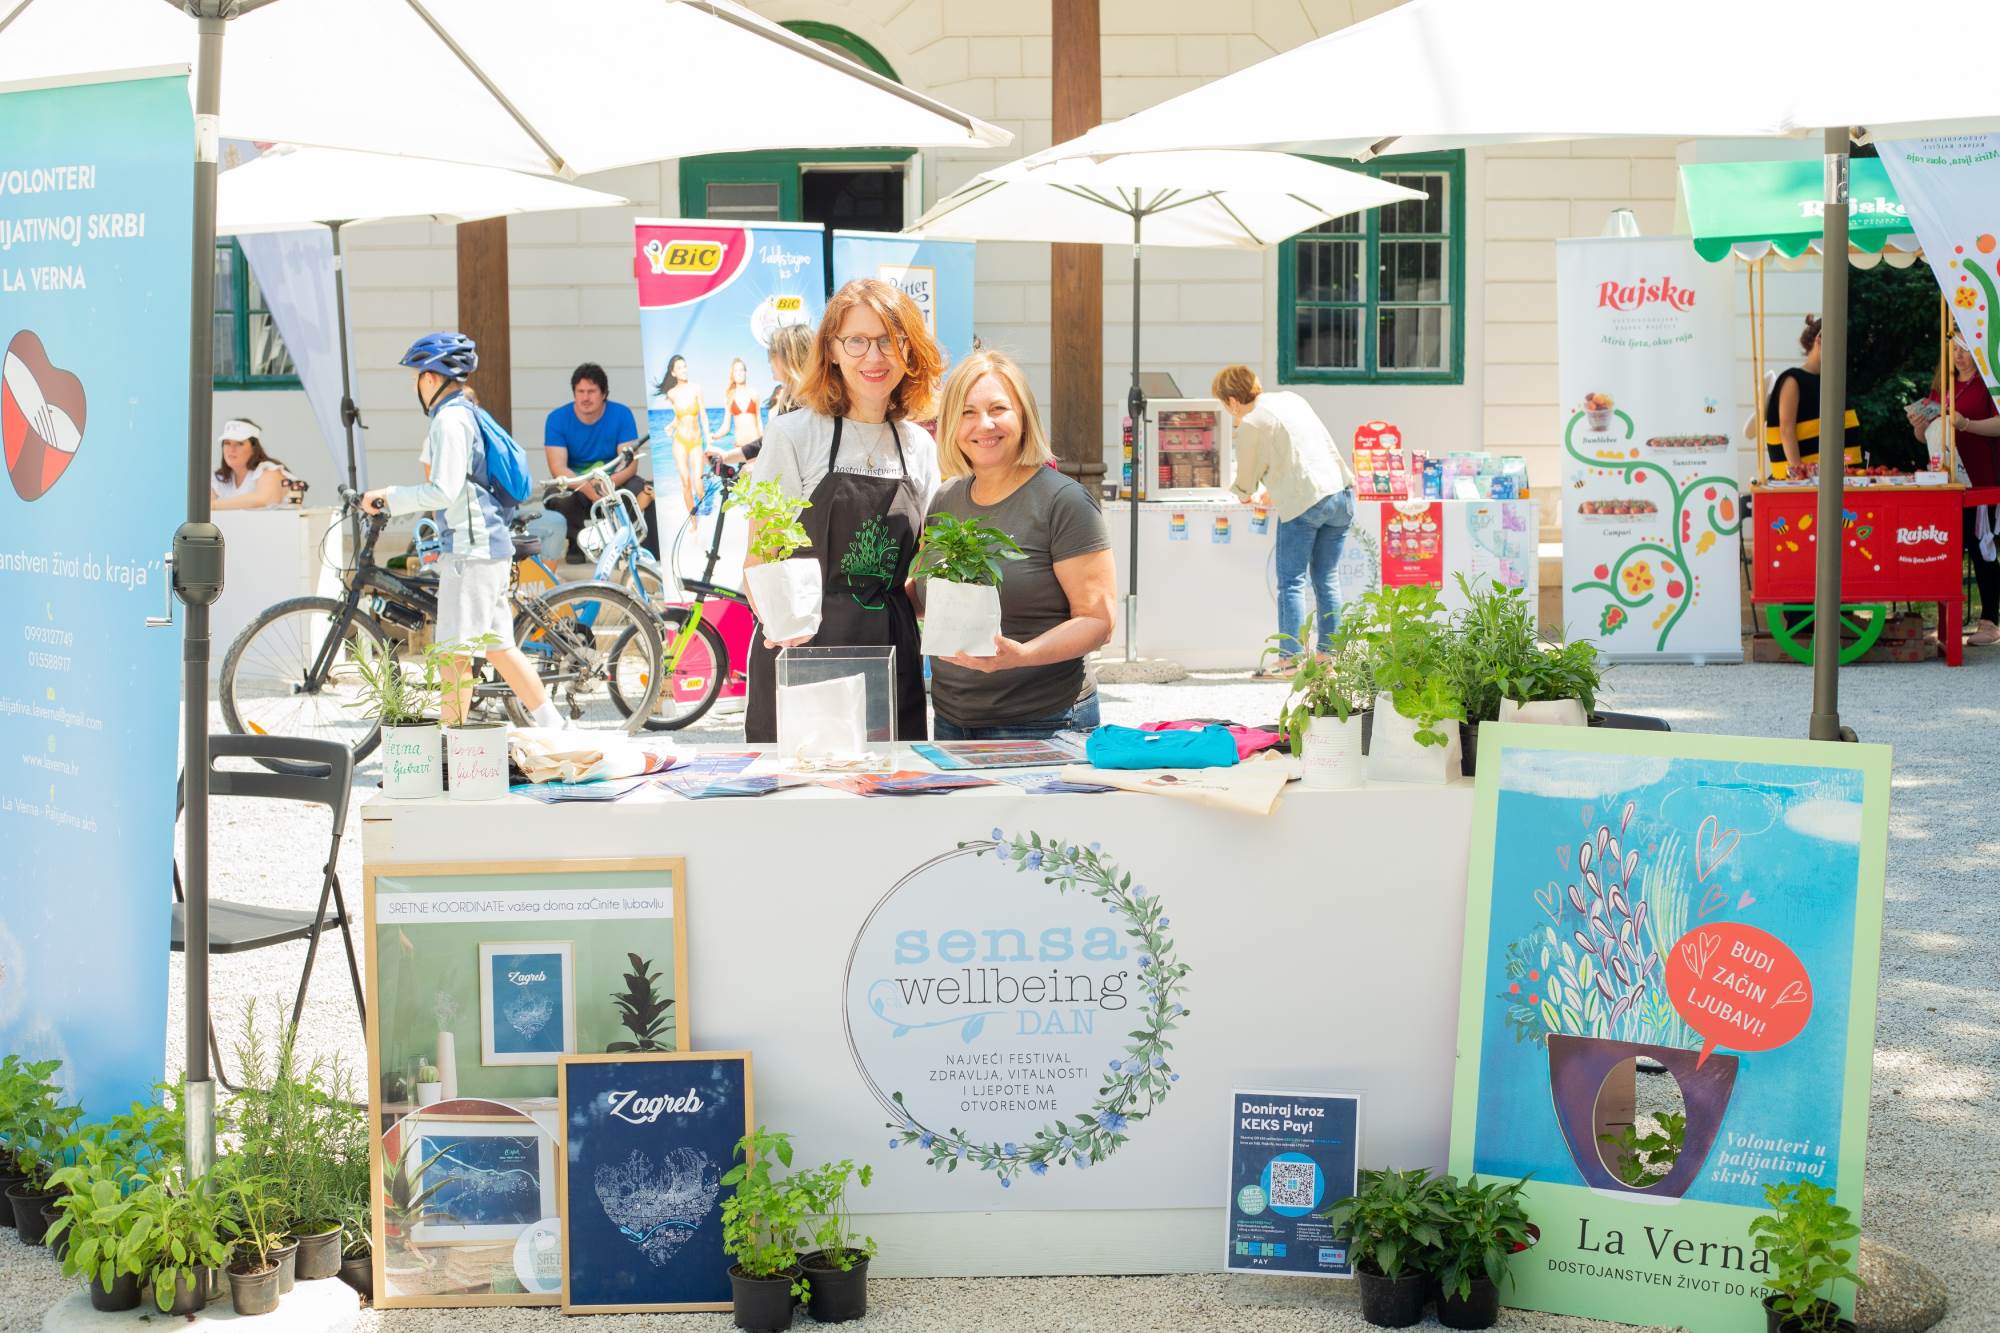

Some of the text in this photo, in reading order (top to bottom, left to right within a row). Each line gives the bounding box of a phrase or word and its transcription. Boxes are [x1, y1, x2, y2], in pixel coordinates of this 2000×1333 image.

[88, 212, 145, 239] SKRBI
[3, 265, 86, 292] LA VERNA
[1597, 275, 1696, 312] Rajska
[1675, 332, 1694, 343] raja
[1896, 525, 1949, 545] Rajska
[52, 552, 79, 578] život
[83, 556, 101, 581] do
[389, 901, 429, 914] SRETNE
[432, 900, 505, 913] KOORDINATE
[543, 899, 574, 912] doma
[895, 926, 1127, 965] sensa
[1730, 941, 1775, 974] BUDI
[508, 971, 547, 985] Zagreb
[895, 968, 1128, 1010] wellbeing
[1712, 966, 1767, 1004] ZAČIN
[1016, 1008, 1097, 1035] DAN
[1687, 987, 1767, 1038] LJUBAVI!
[1009, 1052, 1071, 1064] FESTIVAL
[929, 1067, 1088, 1082] ZDRAVLJA, VITALNOSTI
[973, 1085, 1030, 1096] LJEPOTE
[1036, 1084, 1055, 1095] NA
[608, 1087, 704, 1125] Zagreb
[961, 1099, 1058, 1112] OTVORENOME
[1242, 1102, 1324, 1118] Doniraj kroz
[1241, 1118, 1313, 1134] KEKS Pay!
[1727, 1132, 1826, 1157] Volonteri u
[1711, 1168, 1758, 1186] skrbi
[1718, 1151, 1827, 1178] palijativnoj
[1577, 1218, 1771, 1274] La Verna
[1548, 1259, 1778, 1300] DOSTOJANSTVEN ŽIVOT DO KRA
